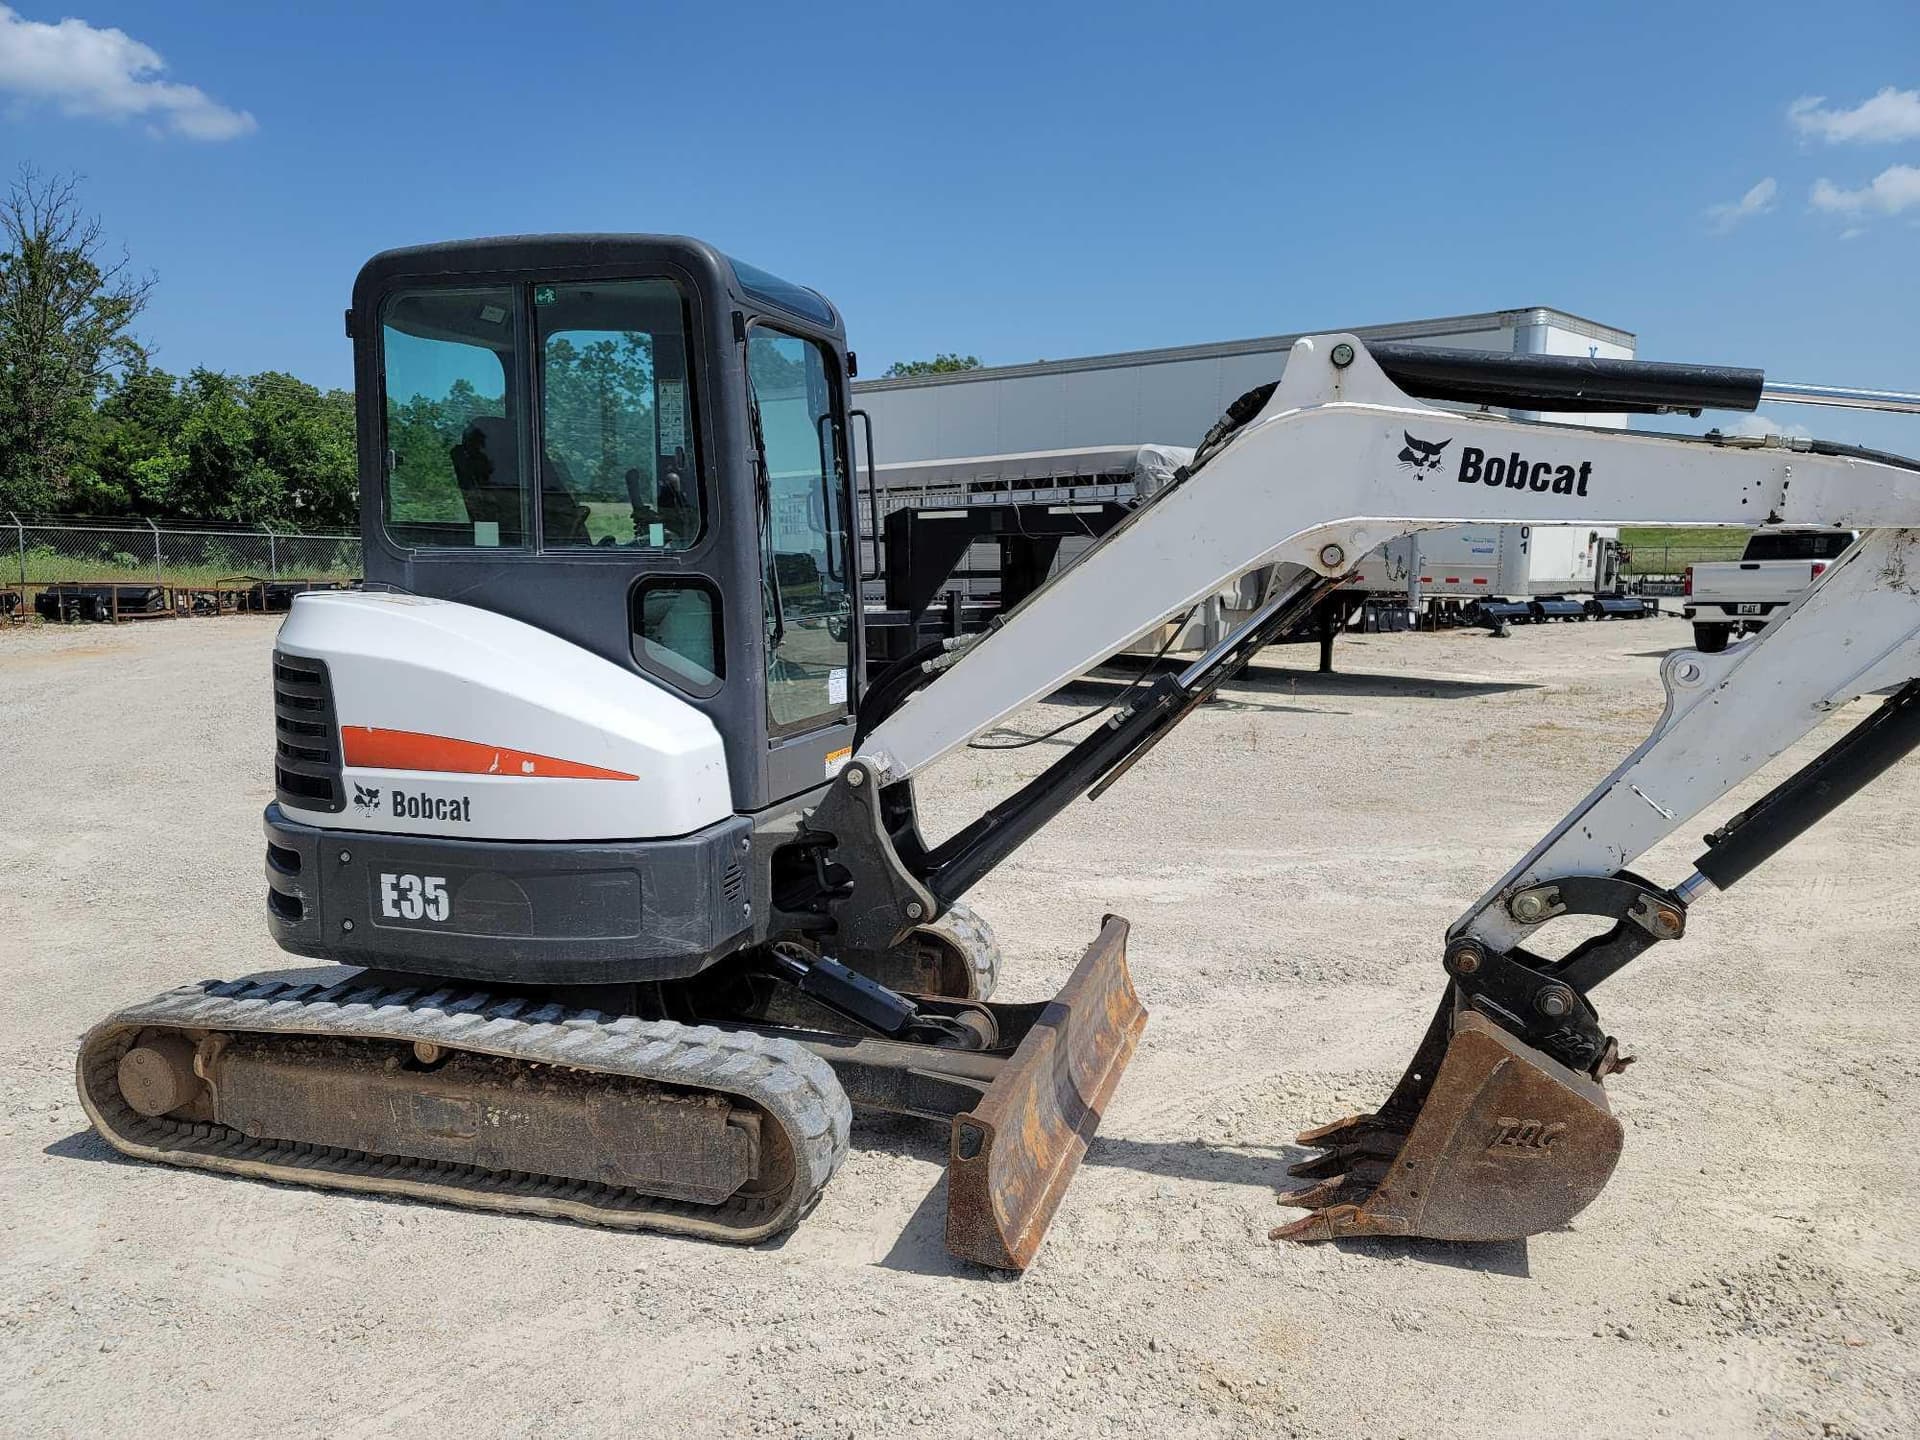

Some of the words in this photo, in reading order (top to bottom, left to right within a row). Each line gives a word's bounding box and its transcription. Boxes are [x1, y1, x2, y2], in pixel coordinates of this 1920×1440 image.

[1458, 447, 1592, 497] Bobcat
[391, 790, 471, 822] Bobcat
[380, 873, 450, 921] E35
